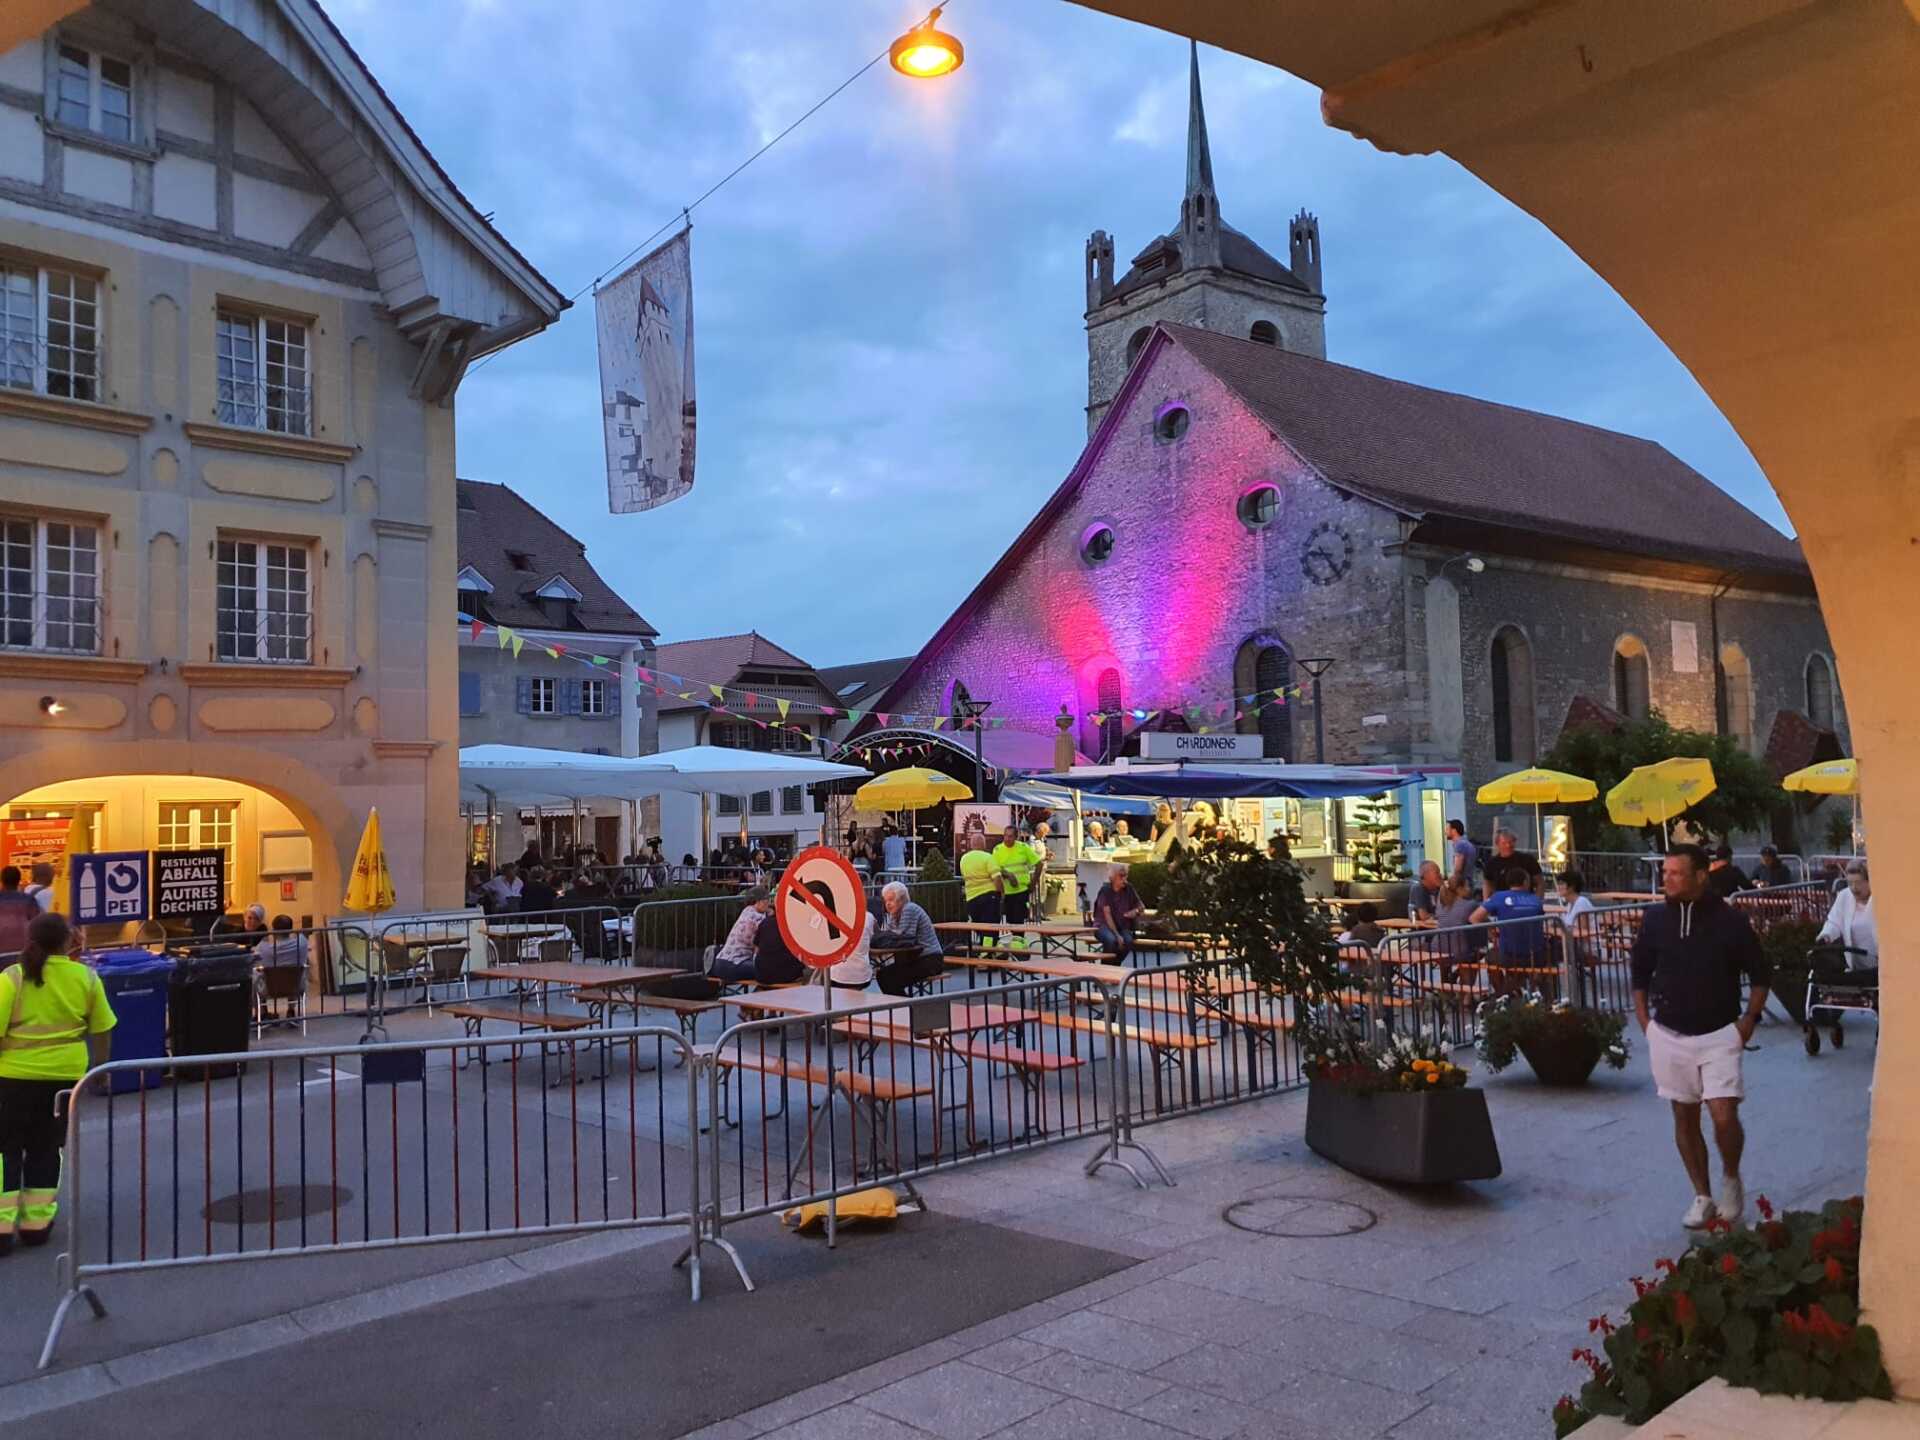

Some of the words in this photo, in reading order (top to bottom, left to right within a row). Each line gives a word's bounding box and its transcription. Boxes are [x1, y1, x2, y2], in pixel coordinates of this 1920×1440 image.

[160, 856, 217, 868] RESTLICHER
[161, 866, 218, 881] ABFALL
[161, 886, 218, 901] AUTRES
[107, 899, 139, 914] PET
[160, 900, 218, 914] DECHETS
